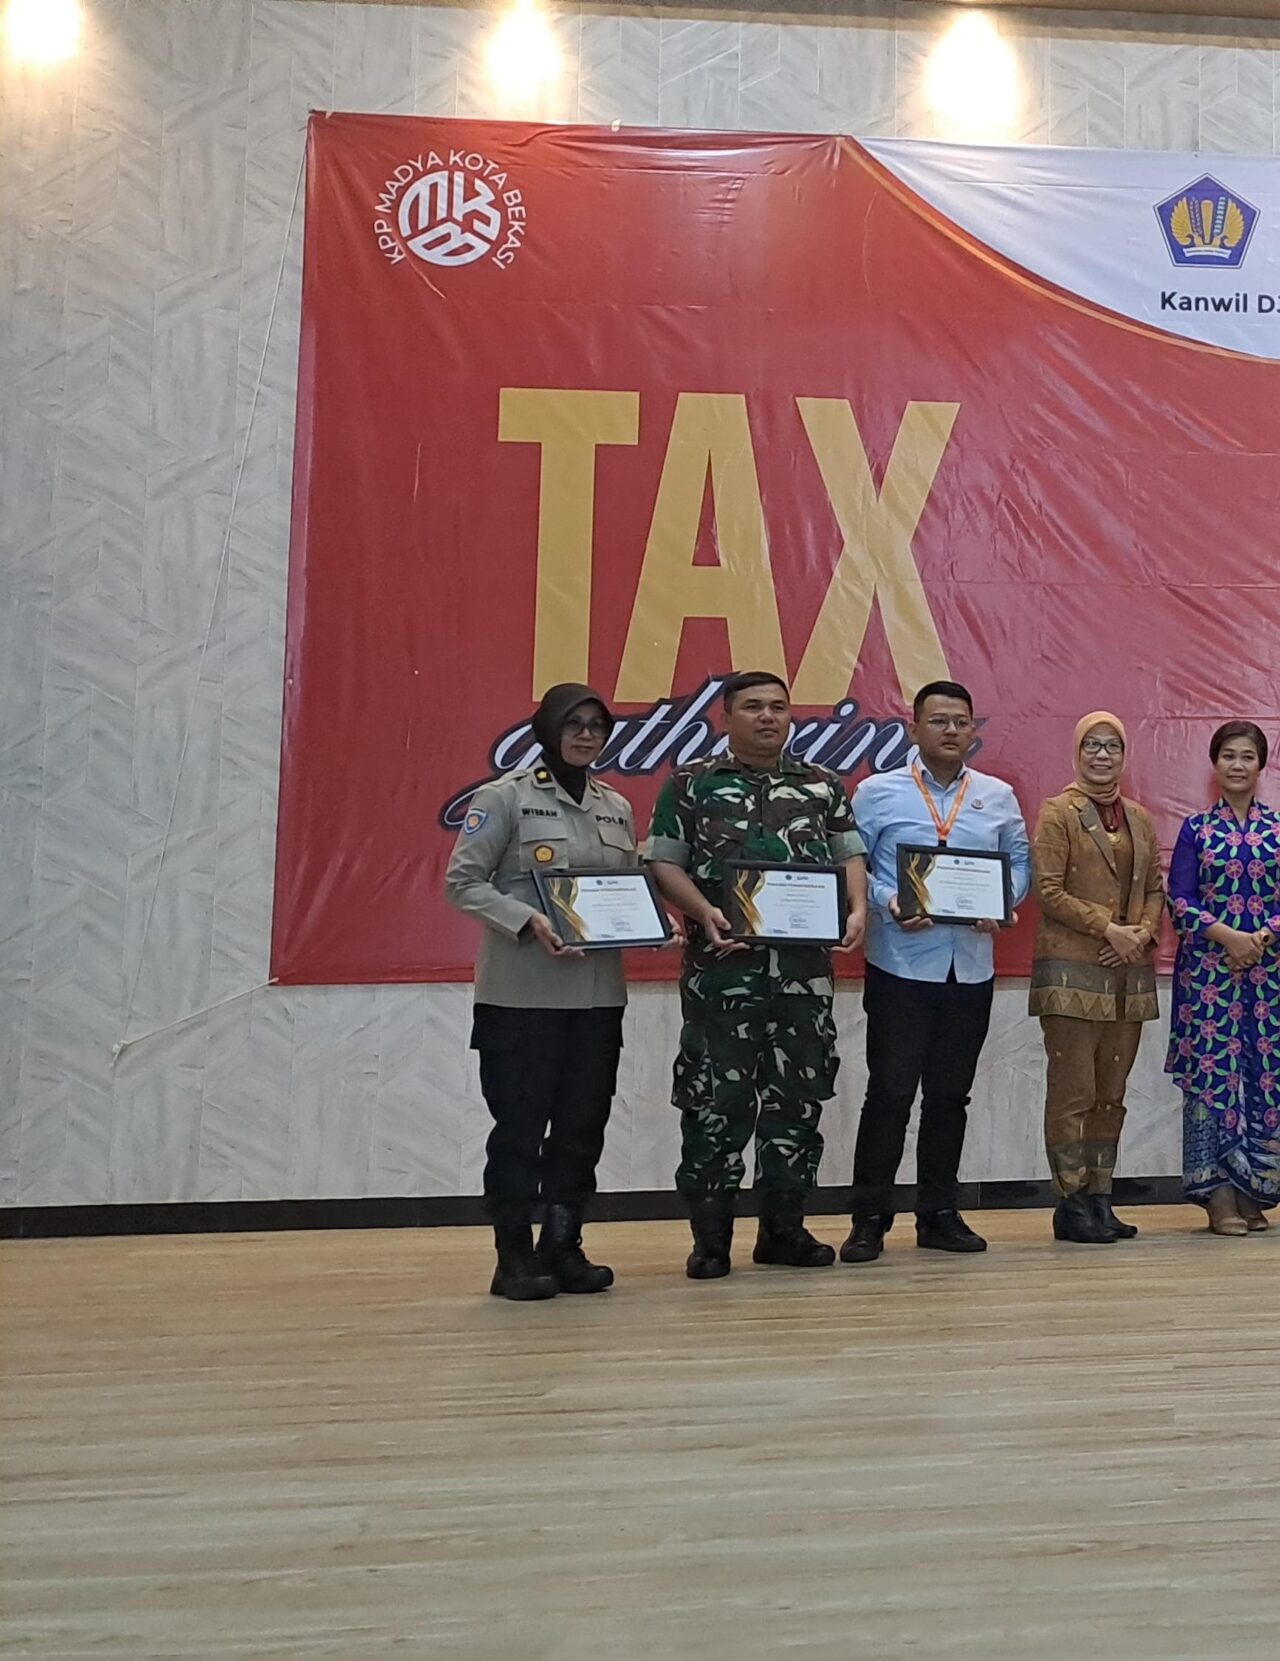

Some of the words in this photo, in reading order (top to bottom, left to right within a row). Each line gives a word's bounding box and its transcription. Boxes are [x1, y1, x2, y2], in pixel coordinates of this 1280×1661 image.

[374, 151, 444, 213] MADYA
[449, 149, 508, 189] KOTA
[374, 219, 406, 264] KPP
[492, 189, 527, 270] BEKASI
[1160, 291, 1249, 313] Kanwil
[498, 387, 962, 706] TAX
